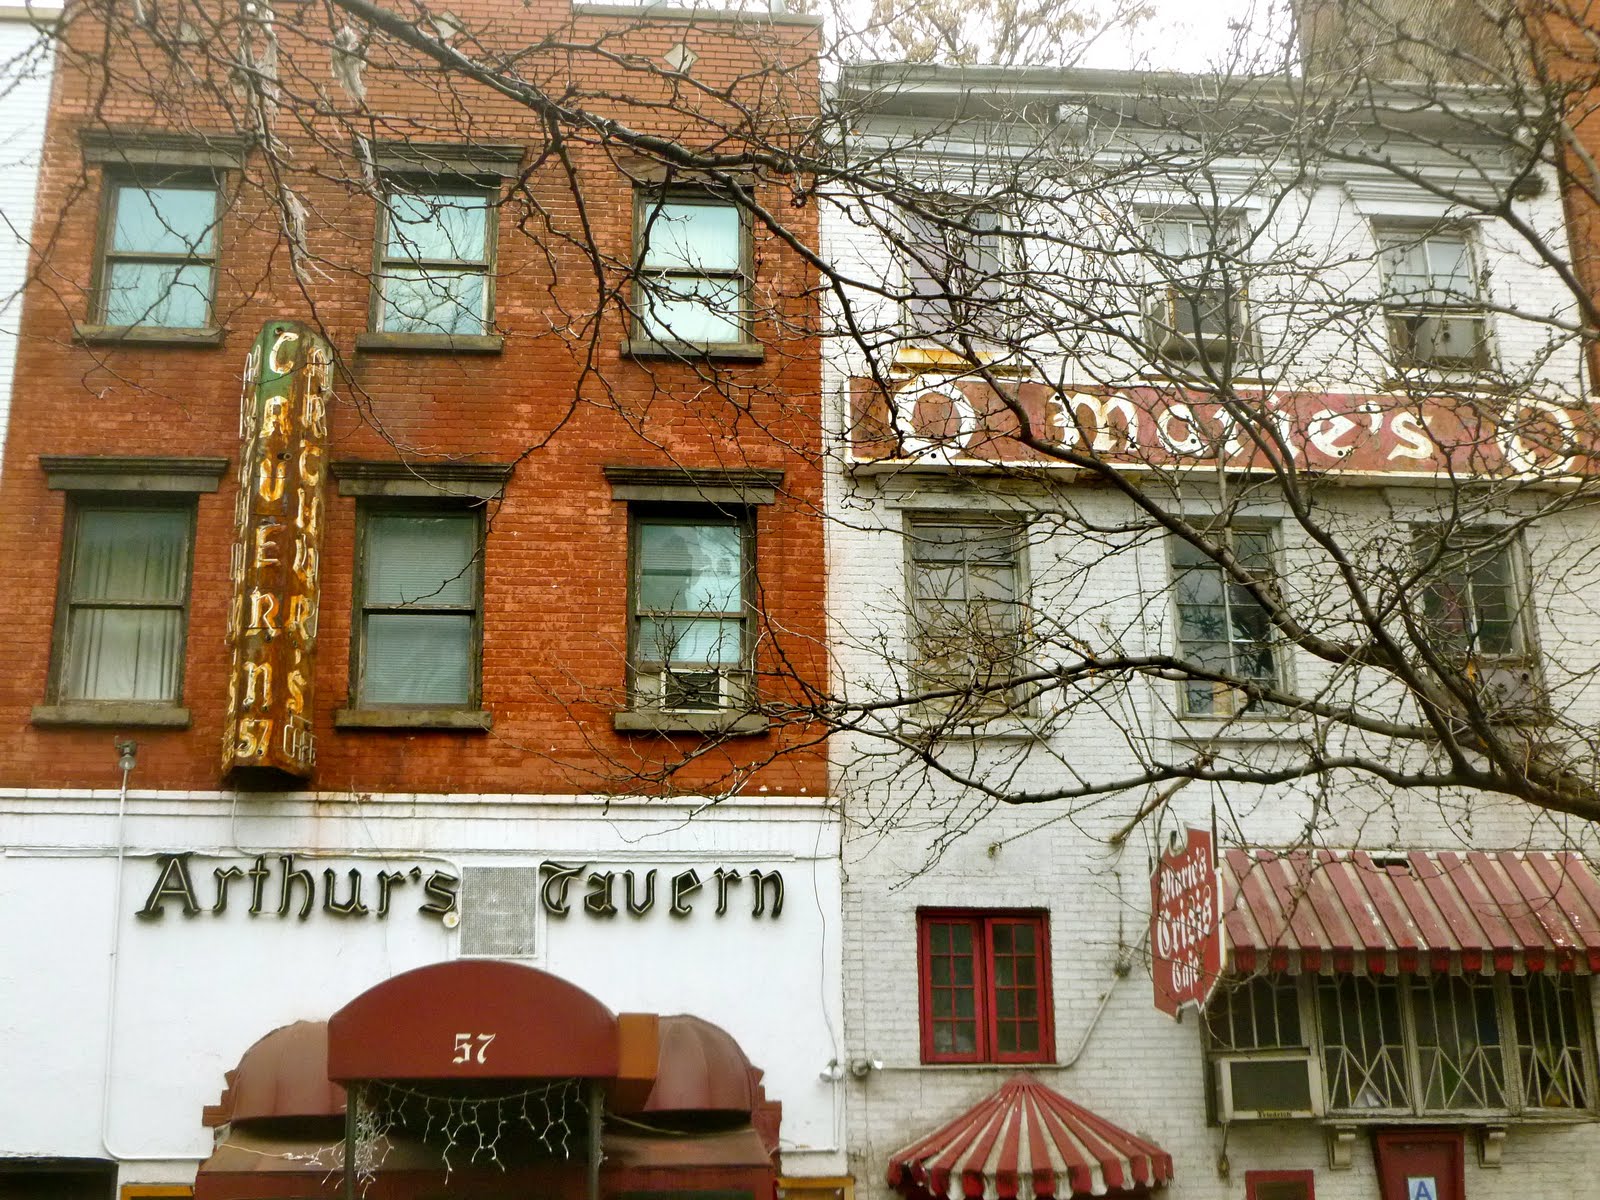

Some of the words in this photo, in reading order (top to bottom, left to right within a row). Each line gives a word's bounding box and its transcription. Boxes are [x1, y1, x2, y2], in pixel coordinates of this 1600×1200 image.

[236, 717, 274, 759] 57
[136, 851, 459, 920] Arthur's
[539, 859, 785, 920] Tavern
[1160, 847, 1207, 905] Marie's
[1157, 884, 1212, 960] Crisis
[1172, 950, 1201, 995] Cafe
[452, 1032, 497, 1065] 57
[1414, 1180, 1433, 1200] A
